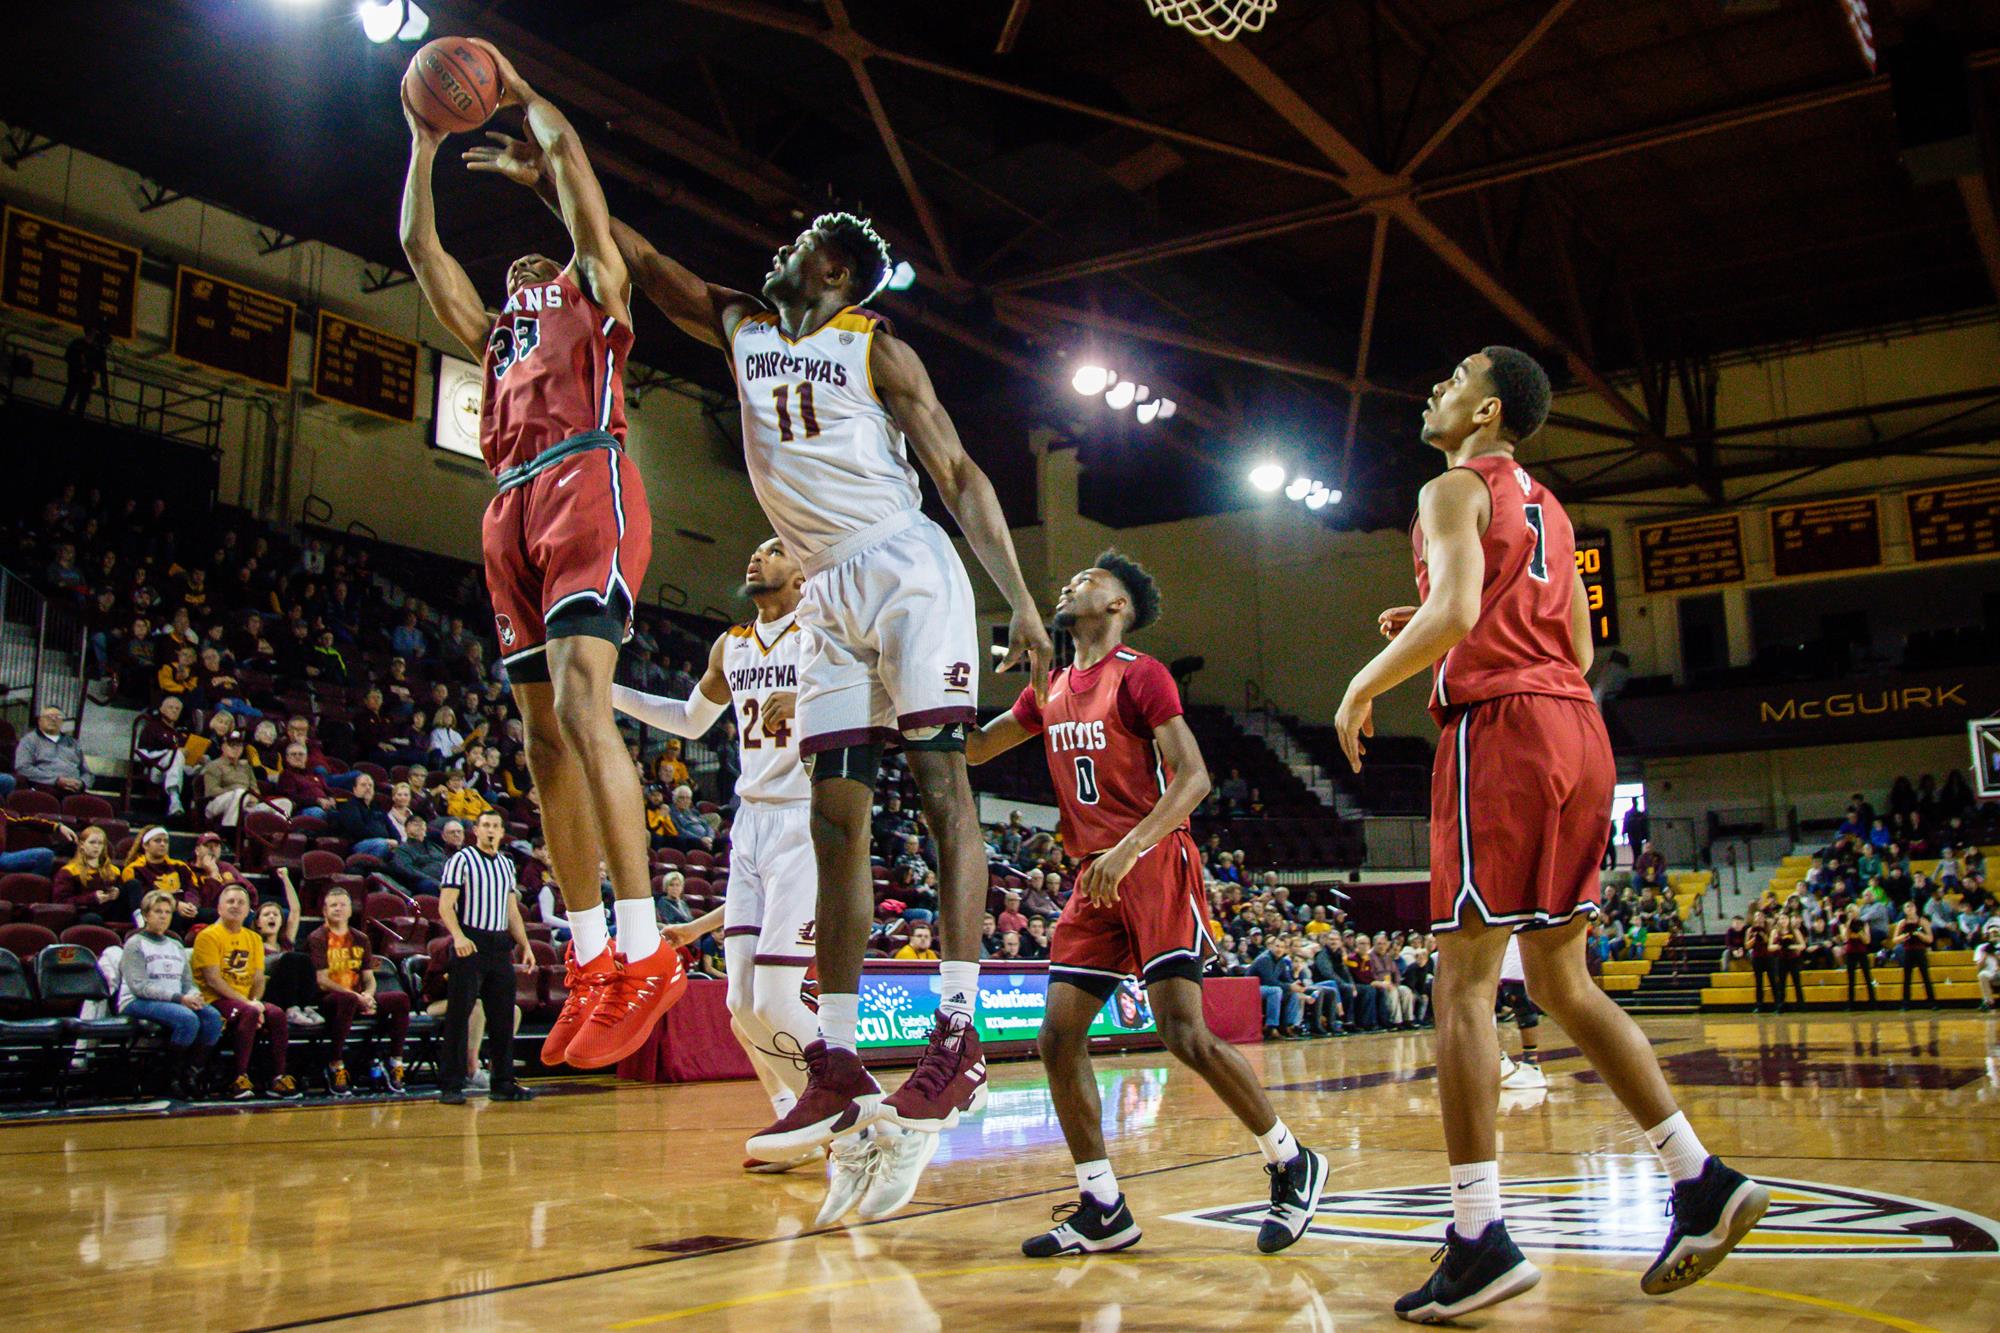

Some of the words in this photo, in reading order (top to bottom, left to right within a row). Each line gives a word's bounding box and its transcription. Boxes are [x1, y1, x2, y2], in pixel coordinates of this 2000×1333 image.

[503, 284, 562, 314] ANS
[489, 316, 541, 381] 33
[745, 351, 847, 387] CHIPPEWAS
[772, 381, 820, 443] 11
[1522, 504, 1549, 583] 1
[729, 664, 798, 692] CHIPPEWA
[742, 698, 792, 749] 24
[1074, 755, 1100, 805] 0
[979, 988, 1046, 1009] Solutions
[855, 1016, 889, 1042] CCU
